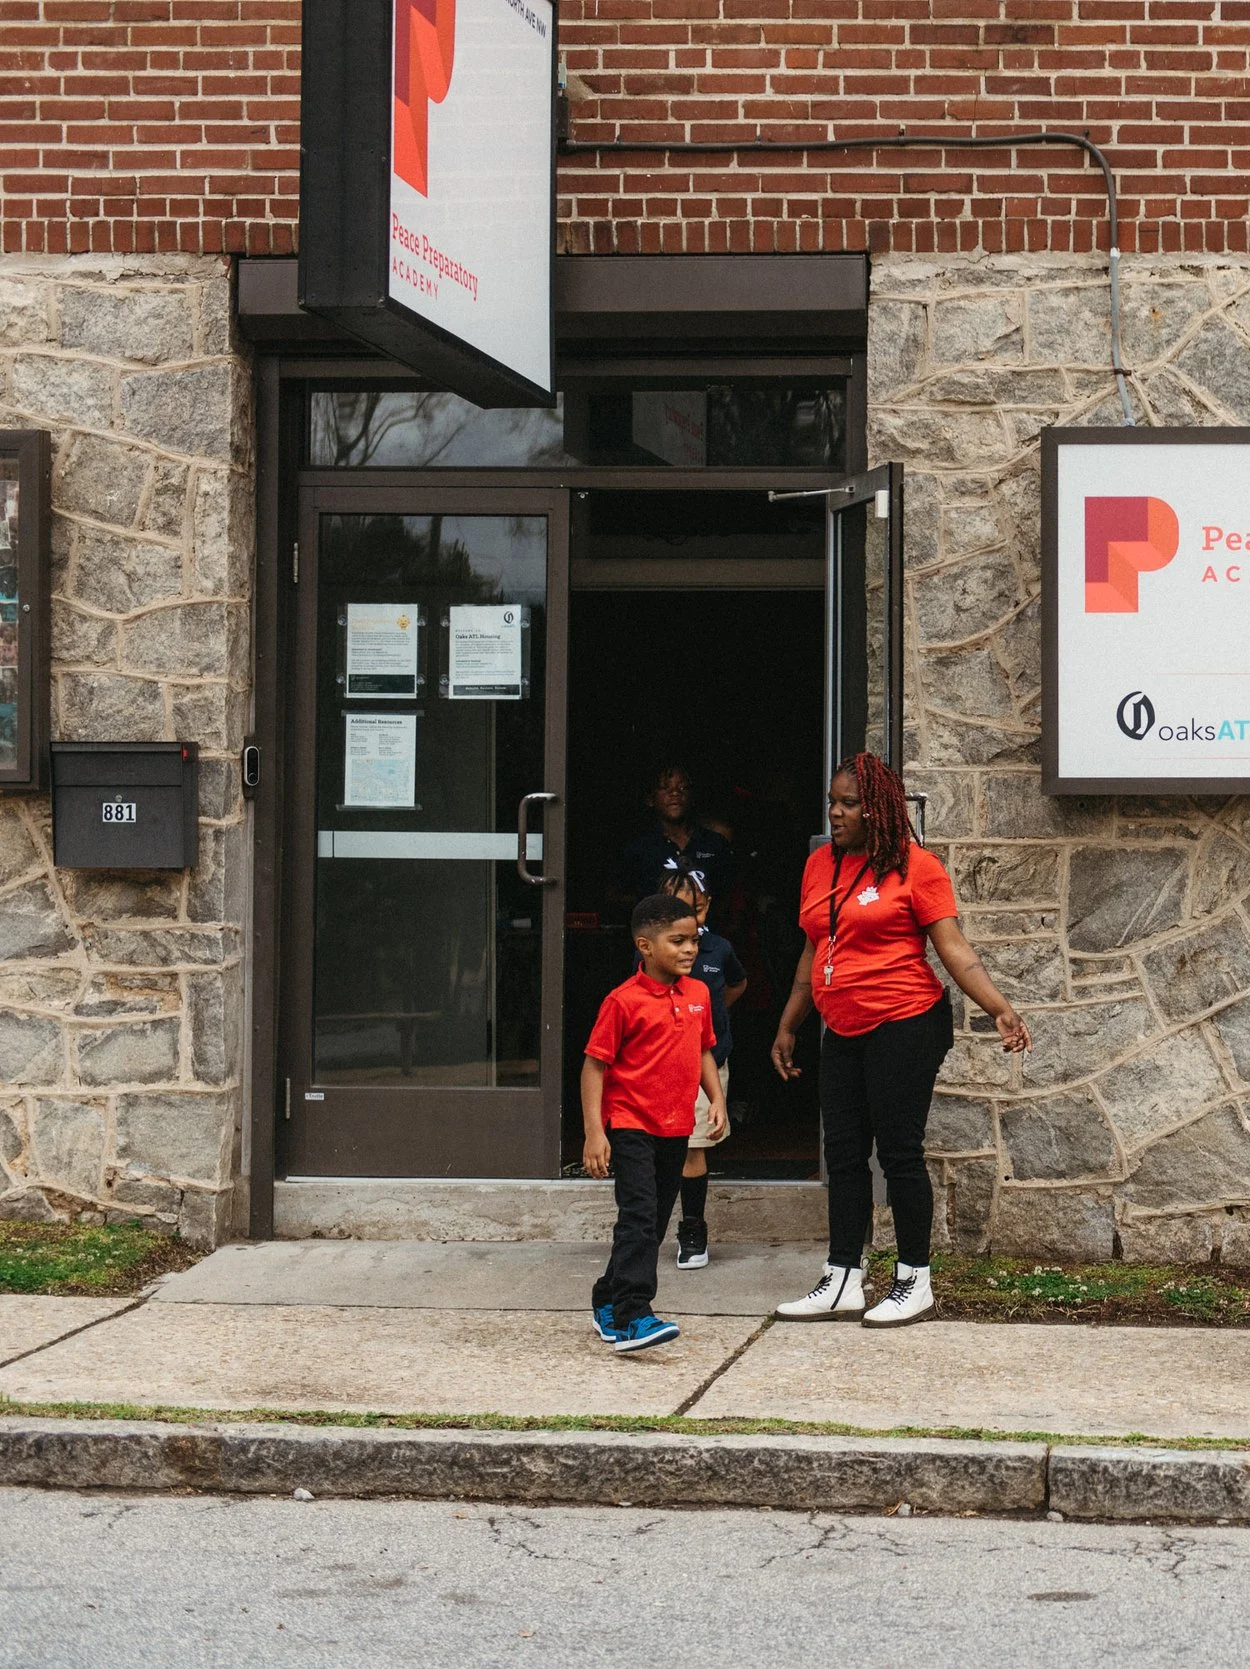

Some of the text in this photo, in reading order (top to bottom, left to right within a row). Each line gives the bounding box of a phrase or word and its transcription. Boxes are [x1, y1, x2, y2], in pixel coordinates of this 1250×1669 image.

[505, 0, 547, 38] ORTH AVE NW
[392, 212, 479, 302] Peace Preparatory
[392, 256, 438, 300] ACADEMY
[103, 804, 135, 821] 881
